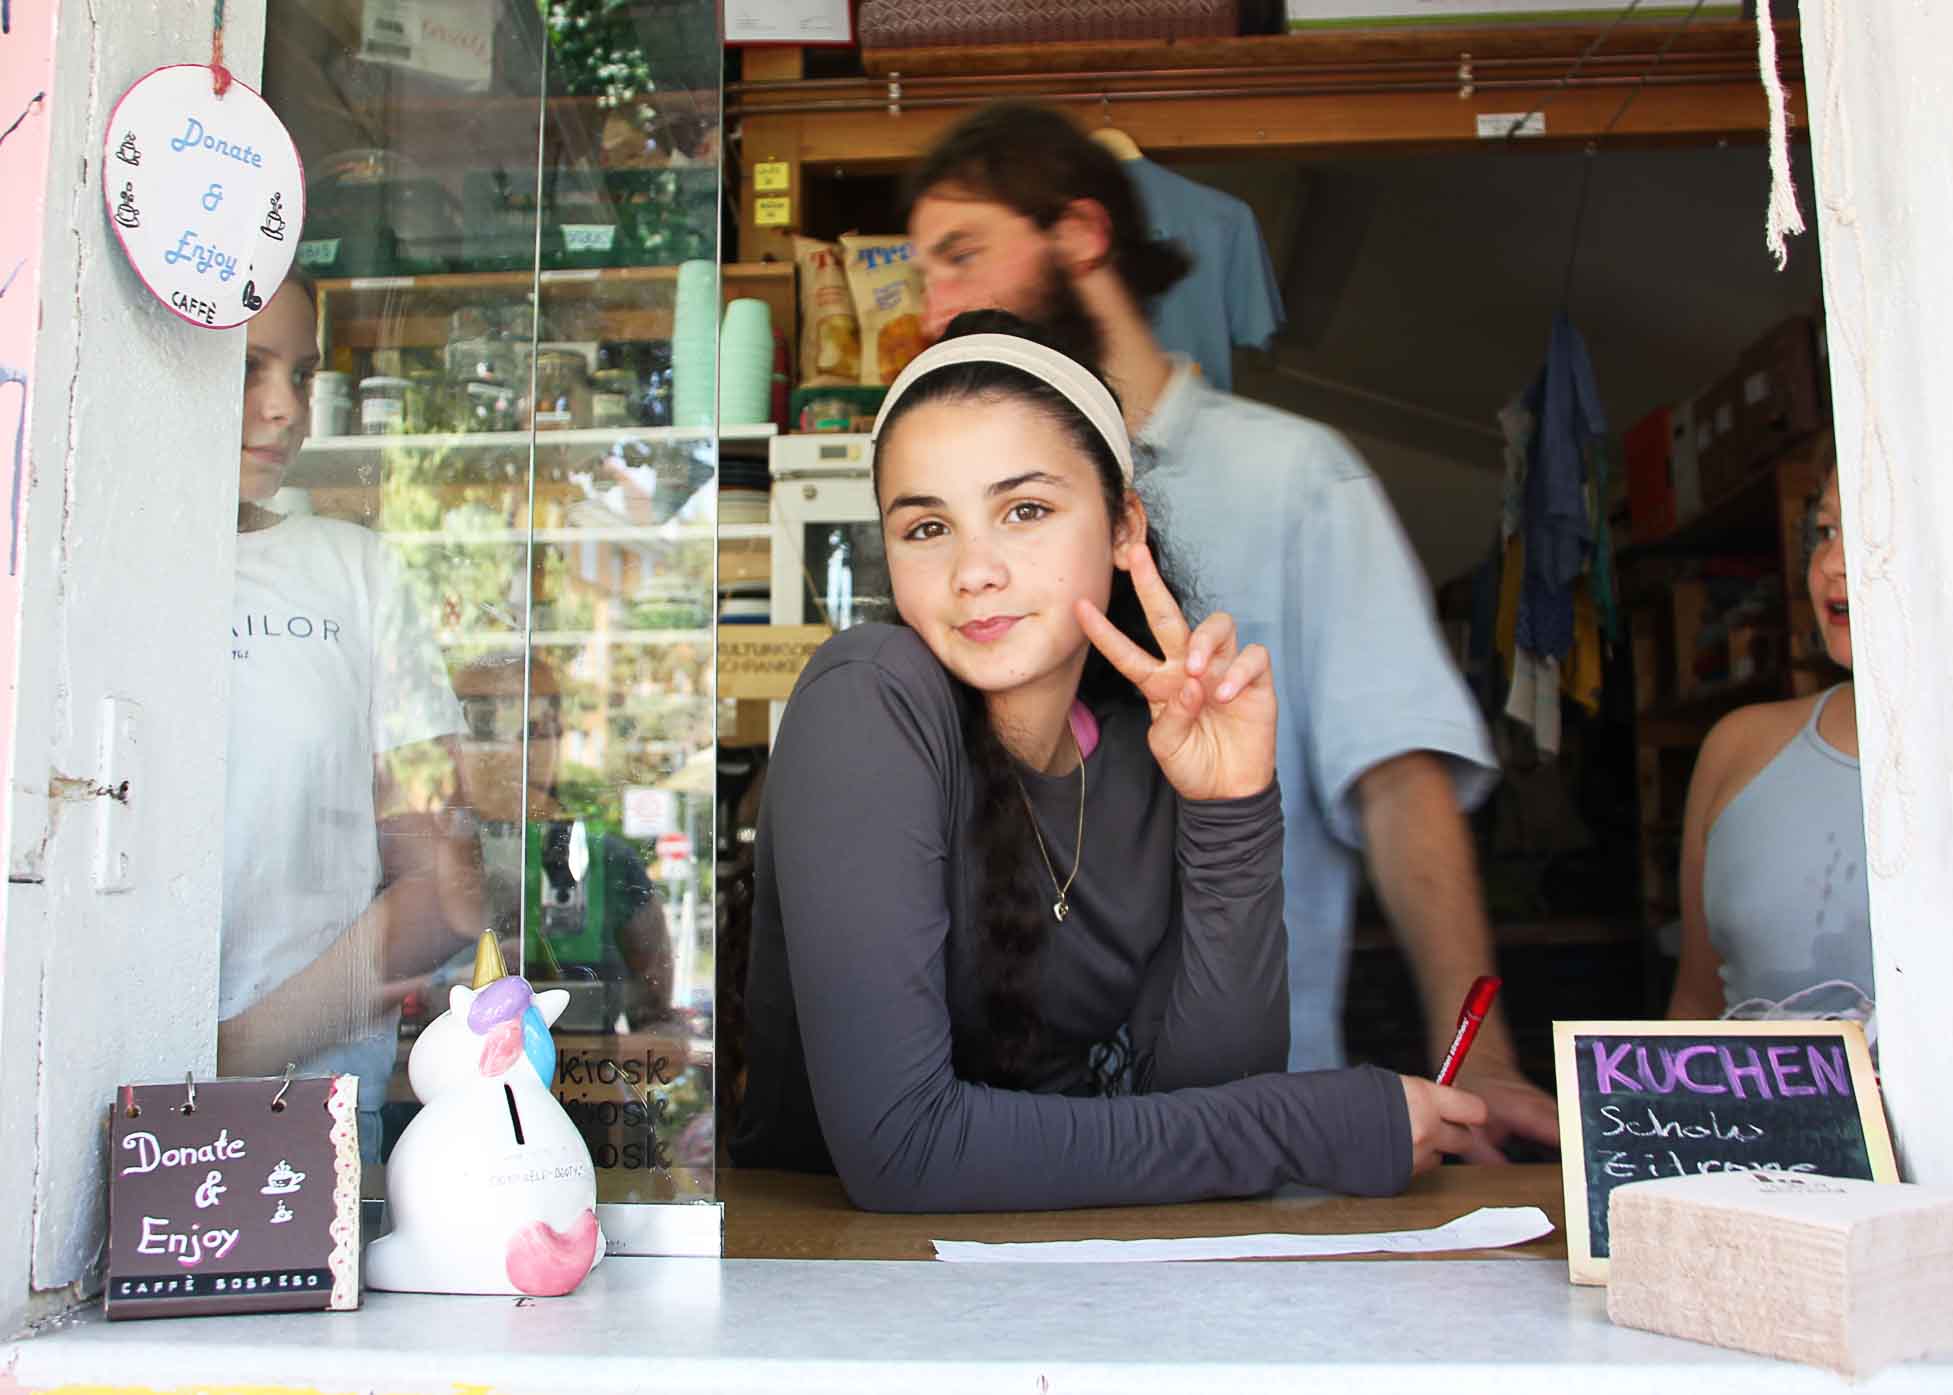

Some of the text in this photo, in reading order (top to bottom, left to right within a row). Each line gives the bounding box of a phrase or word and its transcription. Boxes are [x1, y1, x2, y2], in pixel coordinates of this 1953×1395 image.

[171, 117, 263, 169] Donate
[201, 183, 224, 212] &
[164, 229, 238, 283] Enjoy
[171, 290, 217, 325] CAFFÈ
[558, 1047, 674, 1086] kiosk
[1592, 1041, 1851, 1100] KUCHEN
[121, 1129, 247, 1176] Donate
[596, 1142, 674, 1170] osk
[195, 1170, 227, 1209] &
[137, 1216, 241, 1267] Enjoy
[121, 1274, 319, 1294] CAFFÈ SOSPESO
